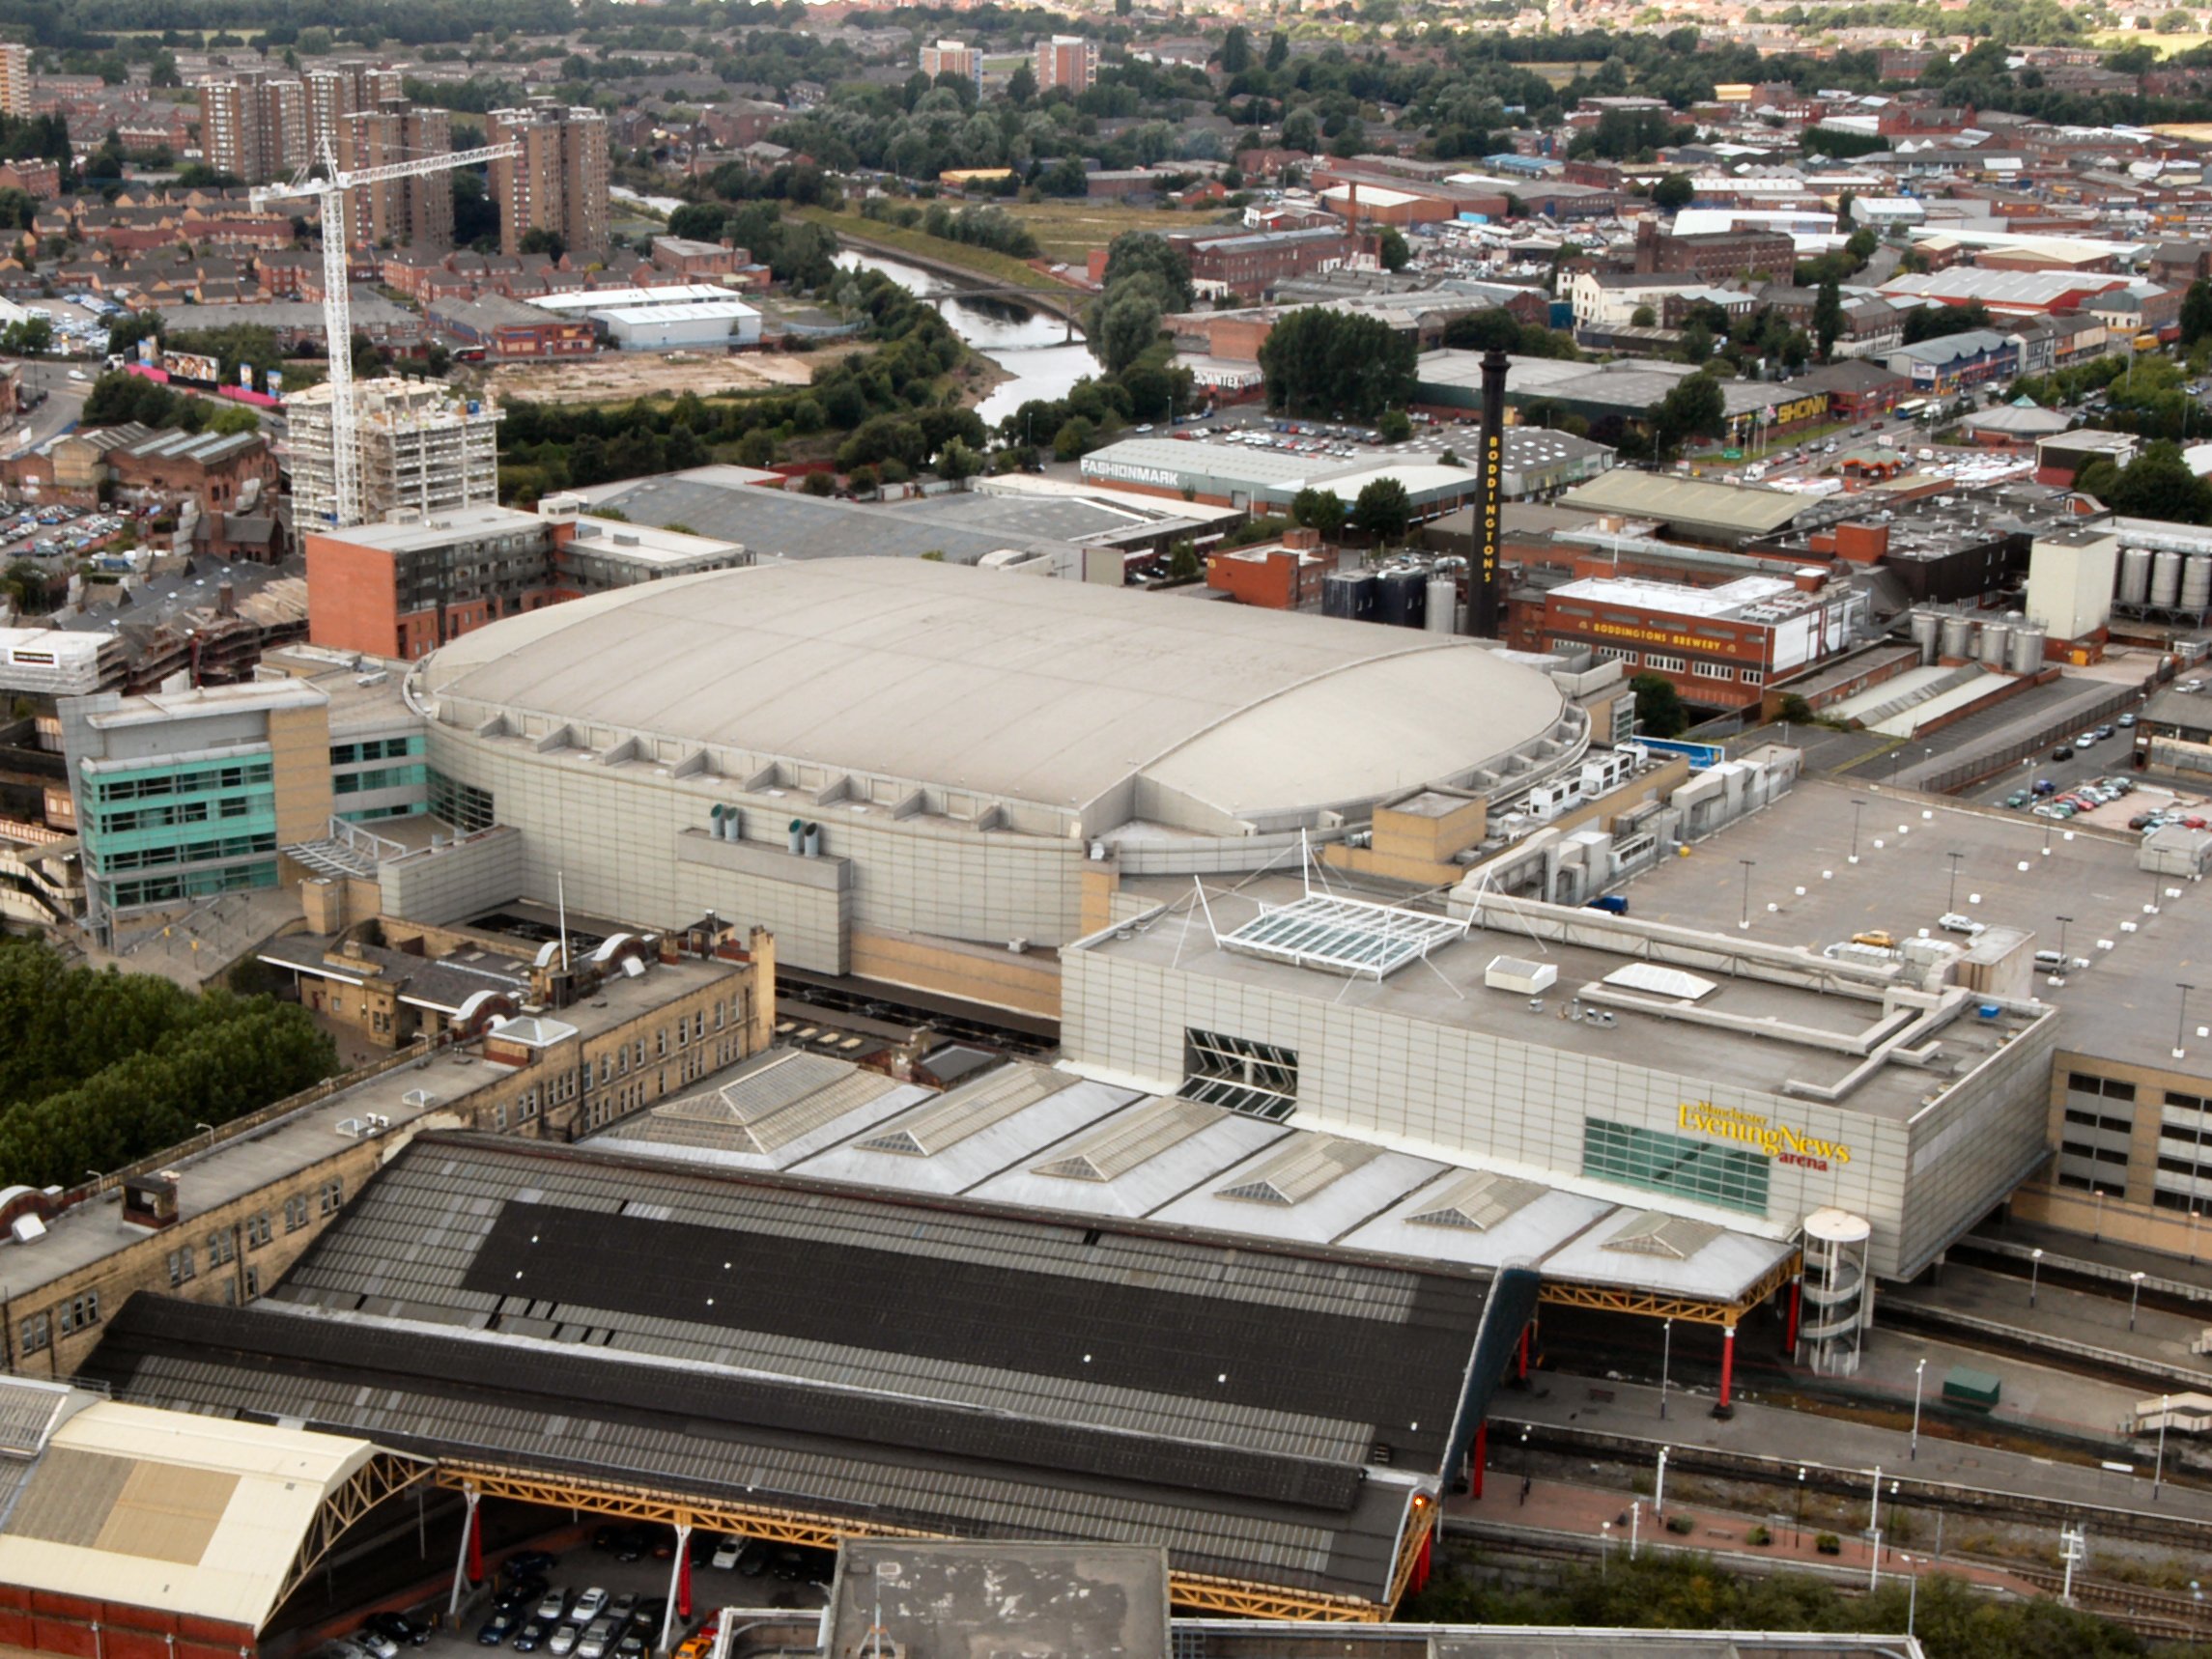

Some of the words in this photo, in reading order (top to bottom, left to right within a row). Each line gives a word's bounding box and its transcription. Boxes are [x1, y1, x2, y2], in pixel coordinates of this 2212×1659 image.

[1081, 459, 1178, 486] FASHIONMARK
[1484, 436, 1498, 582] BODDINGTONS
[1594, 623, 1666, 642] BODDINGTONS
[1673, 635, 1721, 650] BREWERY
[1679, 1103, 1781, 1157] Evening
[1779, 1125, 1851, 1164] News
[1779, 1152, 1828, 1171] arena
